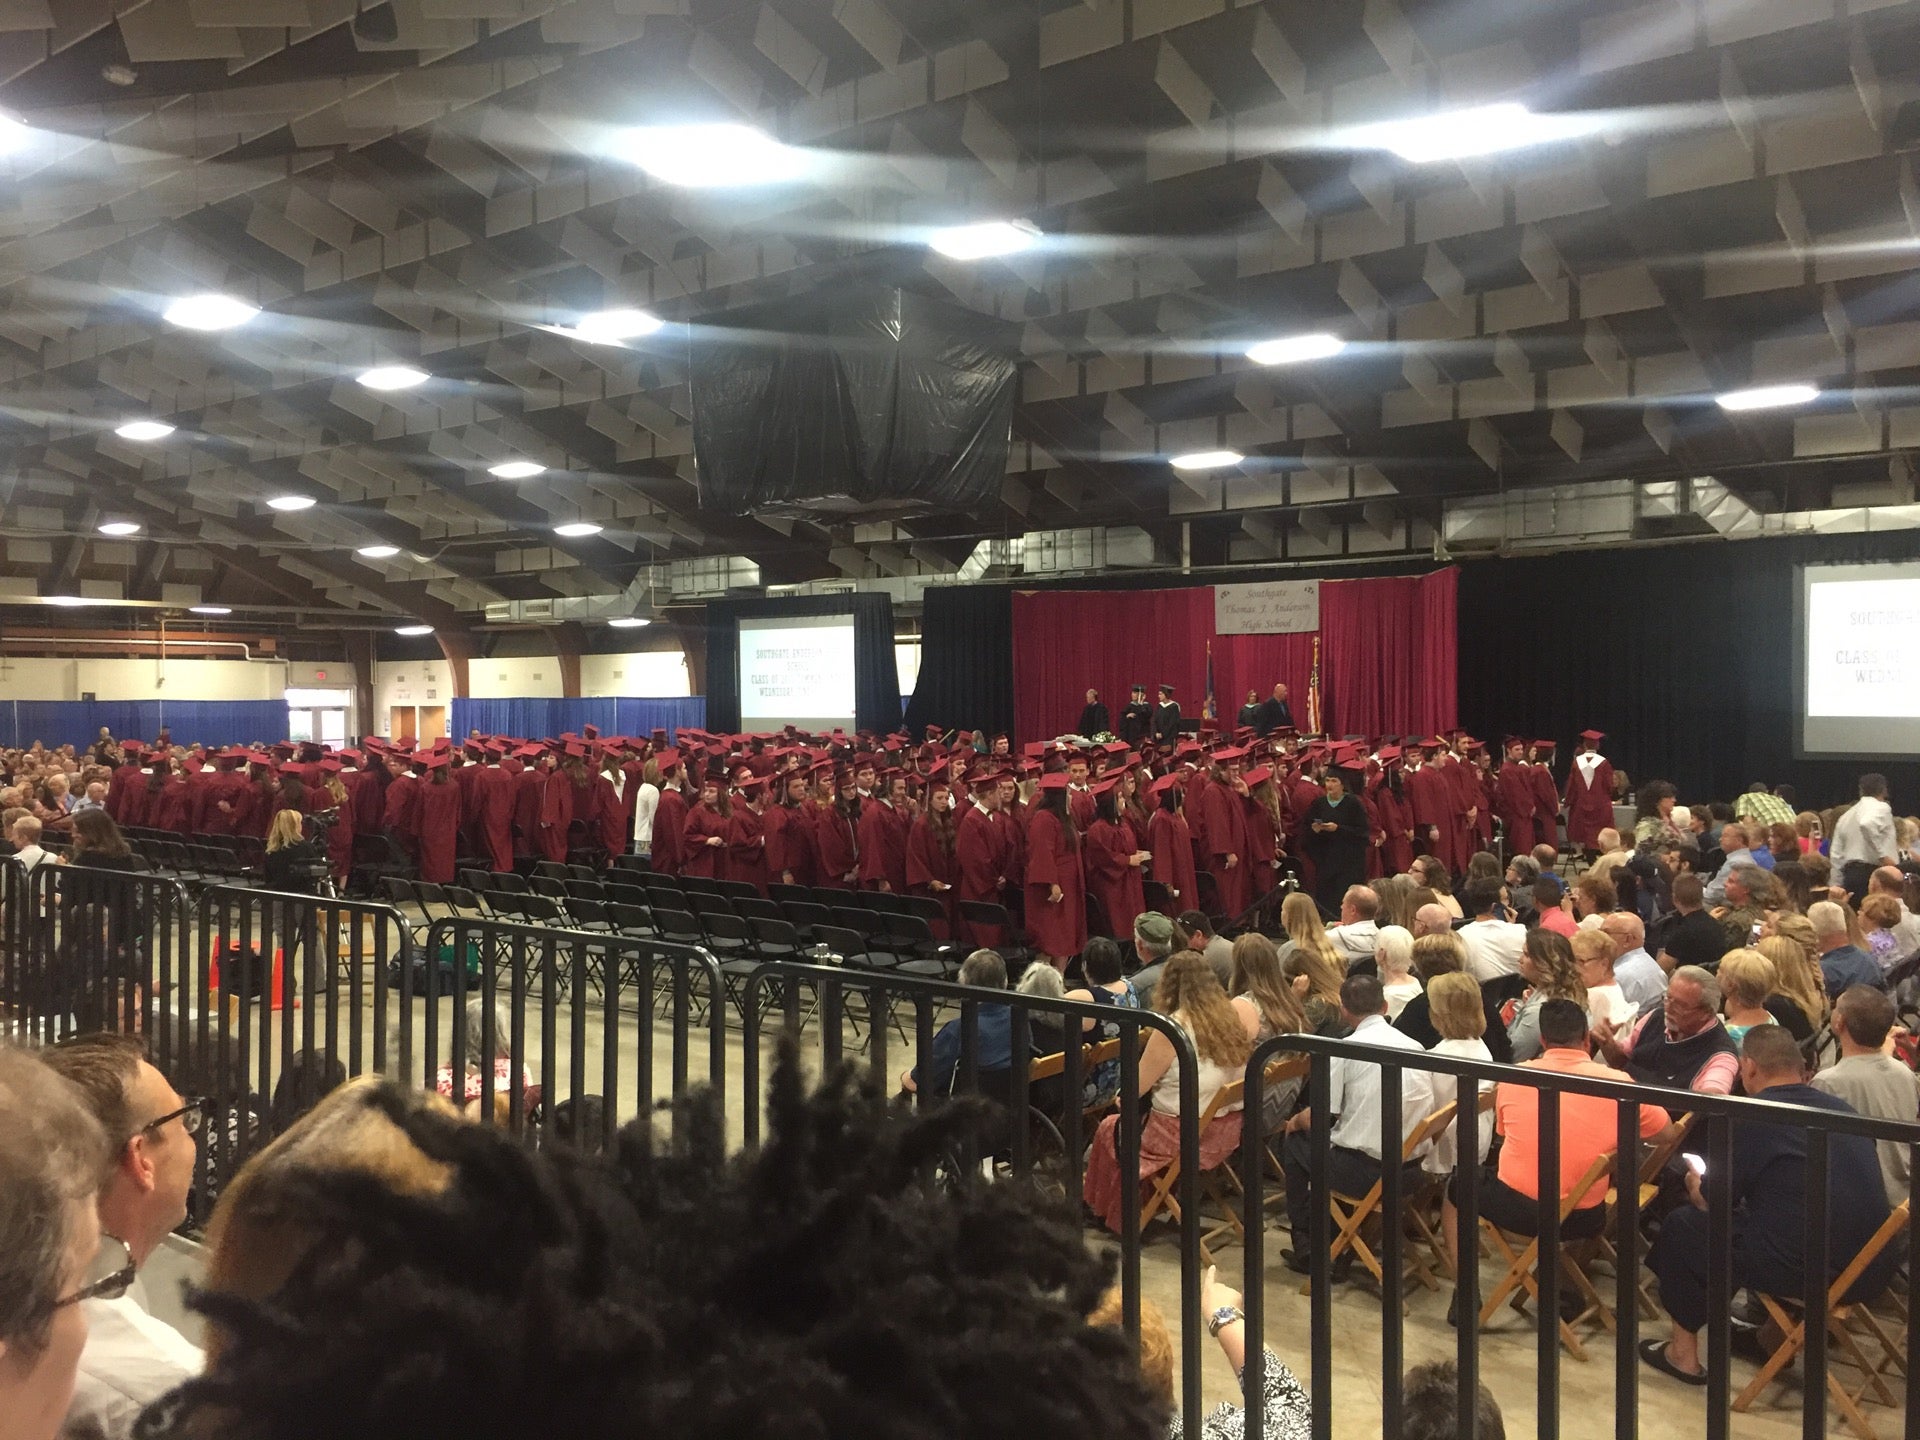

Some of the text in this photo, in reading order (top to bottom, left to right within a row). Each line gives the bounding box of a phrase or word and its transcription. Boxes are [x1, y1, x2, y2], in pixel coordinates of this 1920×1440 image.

[1246, 589, 1288, 600] Southgate
[1224, 604, 1256, 614] Thomas
[1271, 601, 1311, 614] Anderson
[1241, 618, 1293, 631] High School
[756, 649, 789, 660] SOUTHGATE
[1835, 649, 1878, 665] CLASS
[751, 674, 769, 685] CLASS
